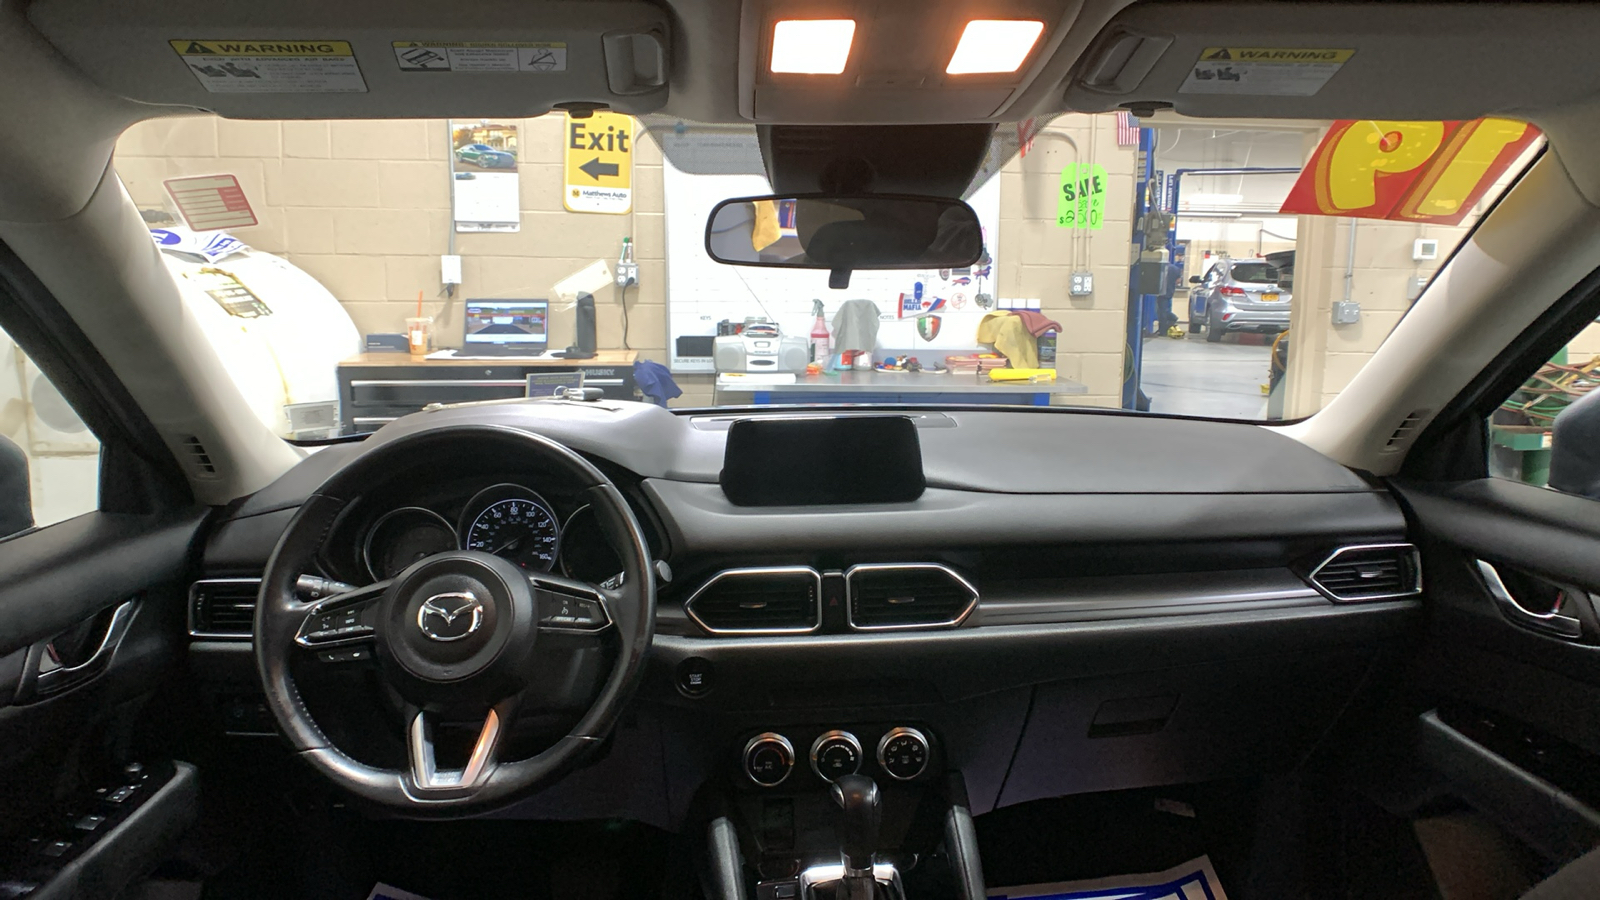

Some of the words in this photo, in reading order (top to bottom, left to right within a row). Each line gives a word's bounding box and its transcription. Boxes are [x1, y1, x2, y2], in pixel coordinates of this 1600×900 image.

[217, 44, 334, 53] WARNING
[1239, 50, 1337, 60] WARNING
[570, 122, 629, 152] Exit
[1063, 176, 1102, 202] SALE
